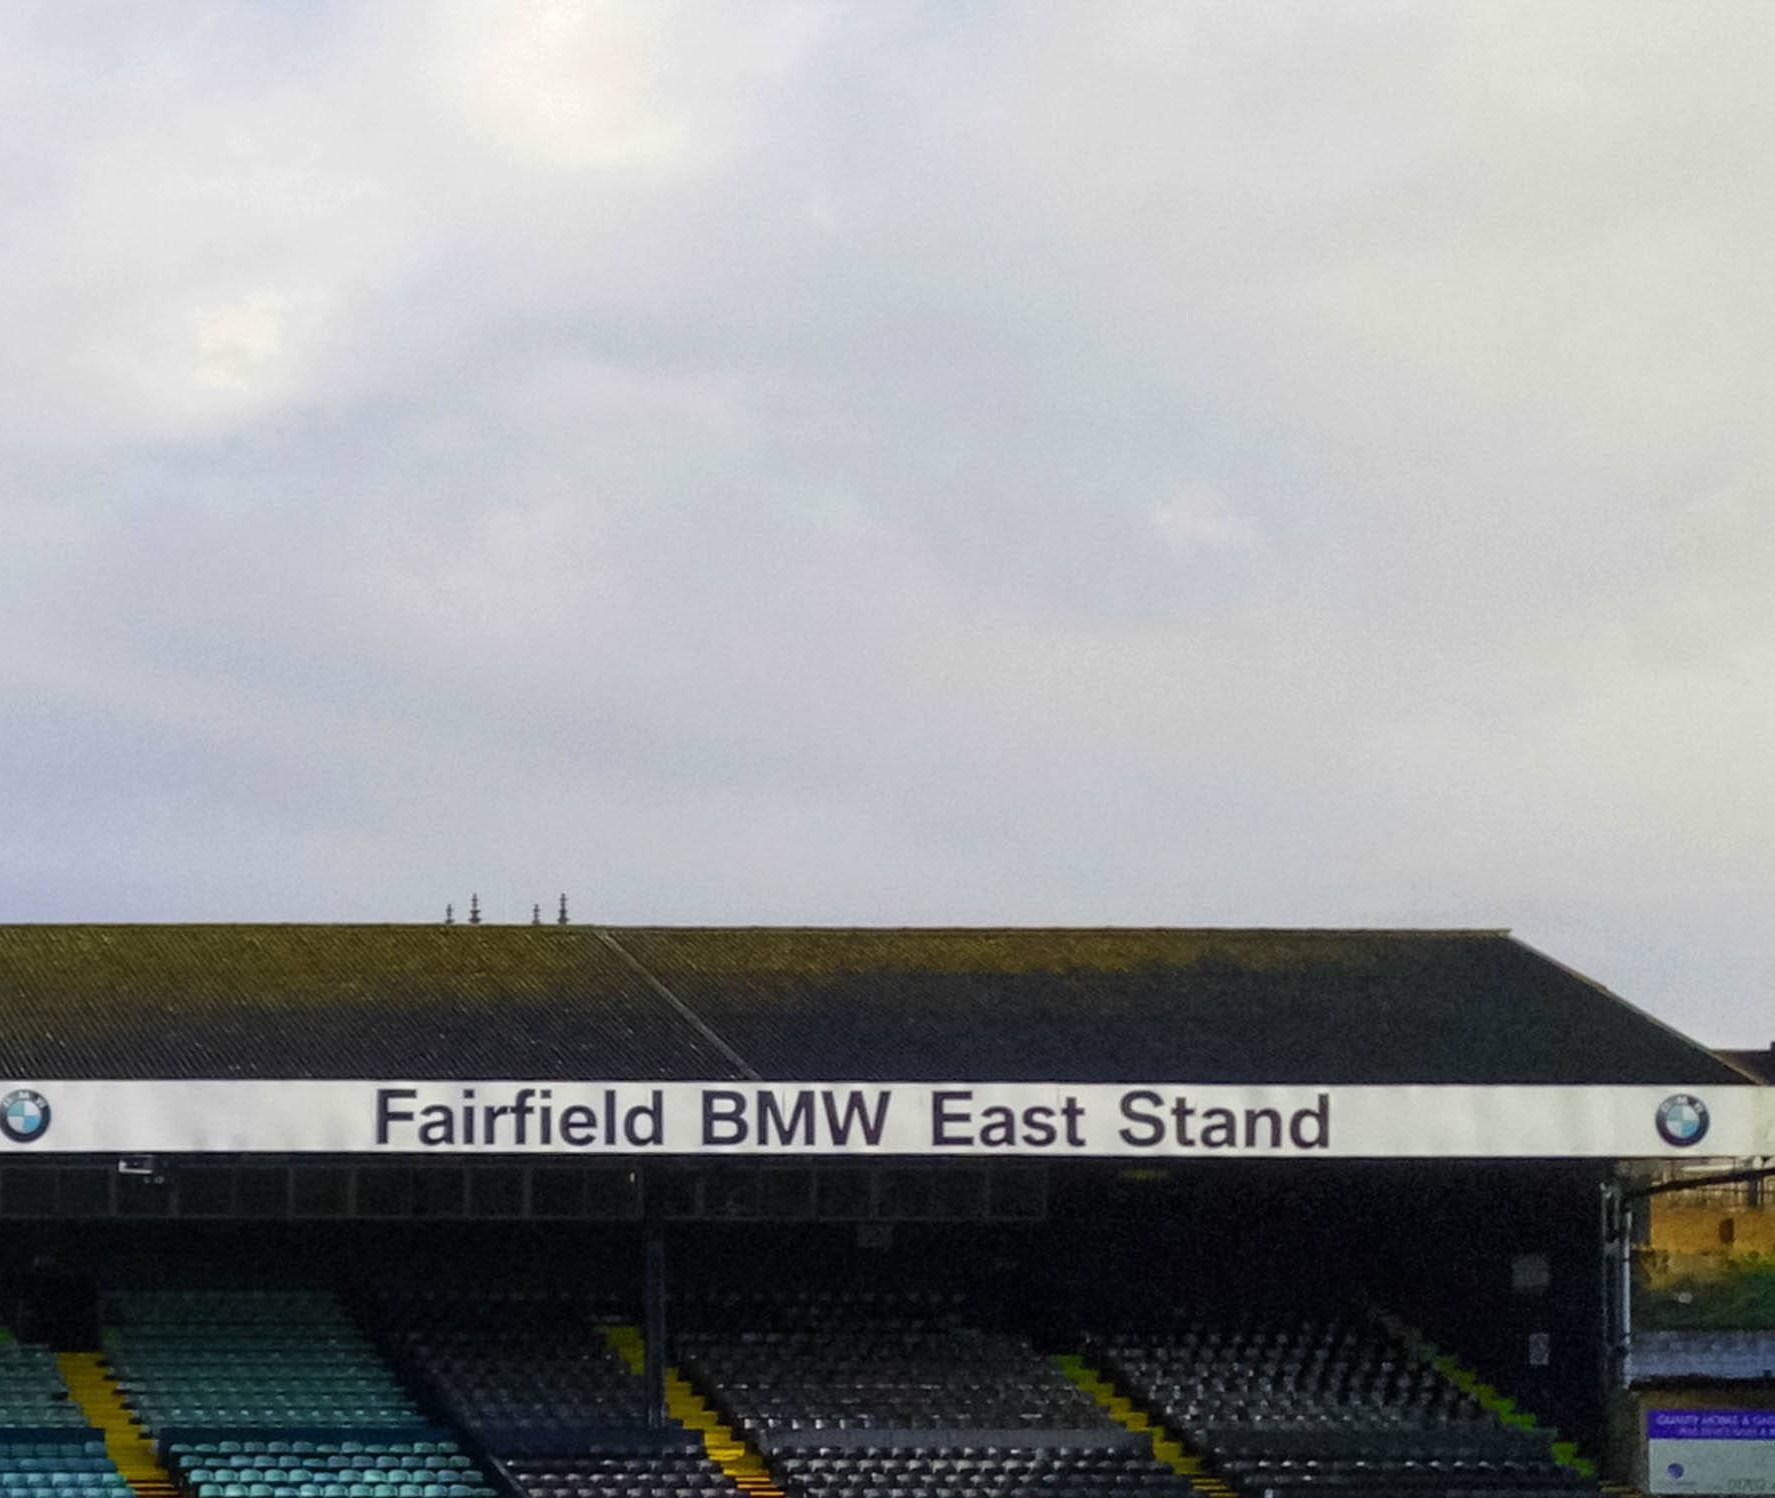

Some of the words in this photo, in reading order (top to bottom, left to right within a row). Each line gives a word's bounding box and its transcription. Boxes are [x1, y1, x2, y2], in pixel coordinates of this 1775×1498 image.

[375, 1088, 665, 1147] Fairfield
[701, 1089, 892, 1146] BMW
[931, 1090, 1087, 1148] East
[1118, 1090, 1330, 1150] Stand
